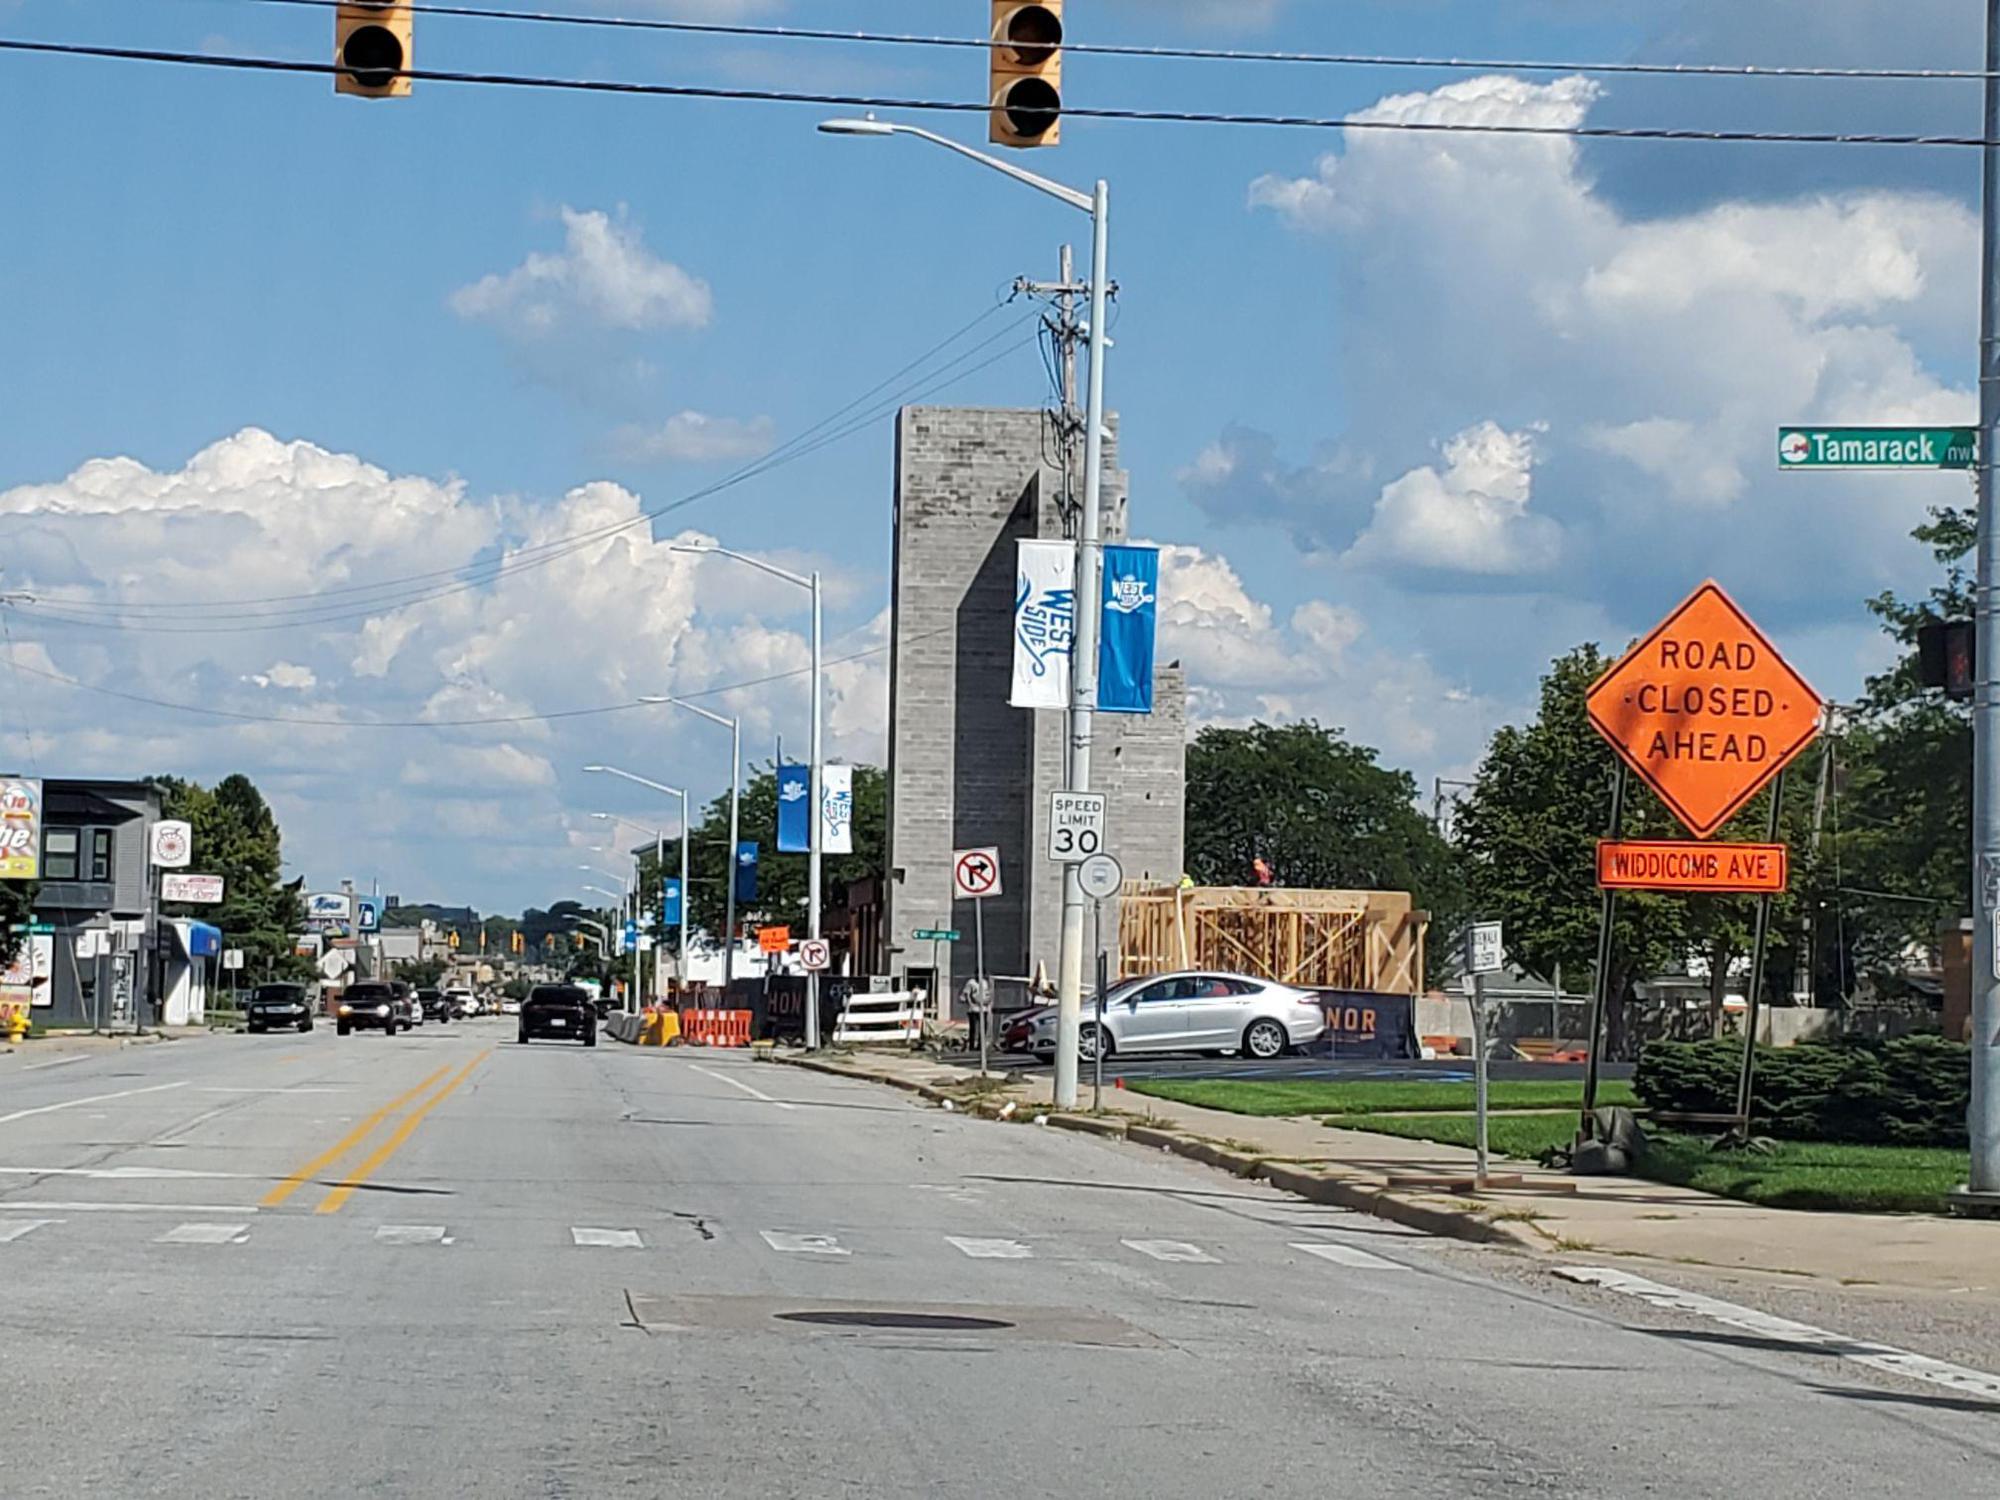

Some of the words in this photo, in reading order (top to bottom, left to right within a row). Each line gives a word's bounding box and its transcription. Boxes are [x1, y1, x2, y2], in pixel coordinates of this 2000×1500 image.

[1812, 433, 1934, 462] Tamarack
[1021, 605, 1047, 648] SIDE
[1038, 588, 1076, 658] WEST
[1660, 640, 1756, 671] ROAD
[1637, 684, 1774, 717] CLOSED
[1646, 731, 1767, 762] AHEAD
[1055, 799, 1101, 812] SPEED
[1059, 814, 1095, 826] LIMIT
[1055, 828, 1098, 853] 30
[1613, 853, 1718, 879] WIDDICOMB
[1727, 854, 1768, 879] AVE
